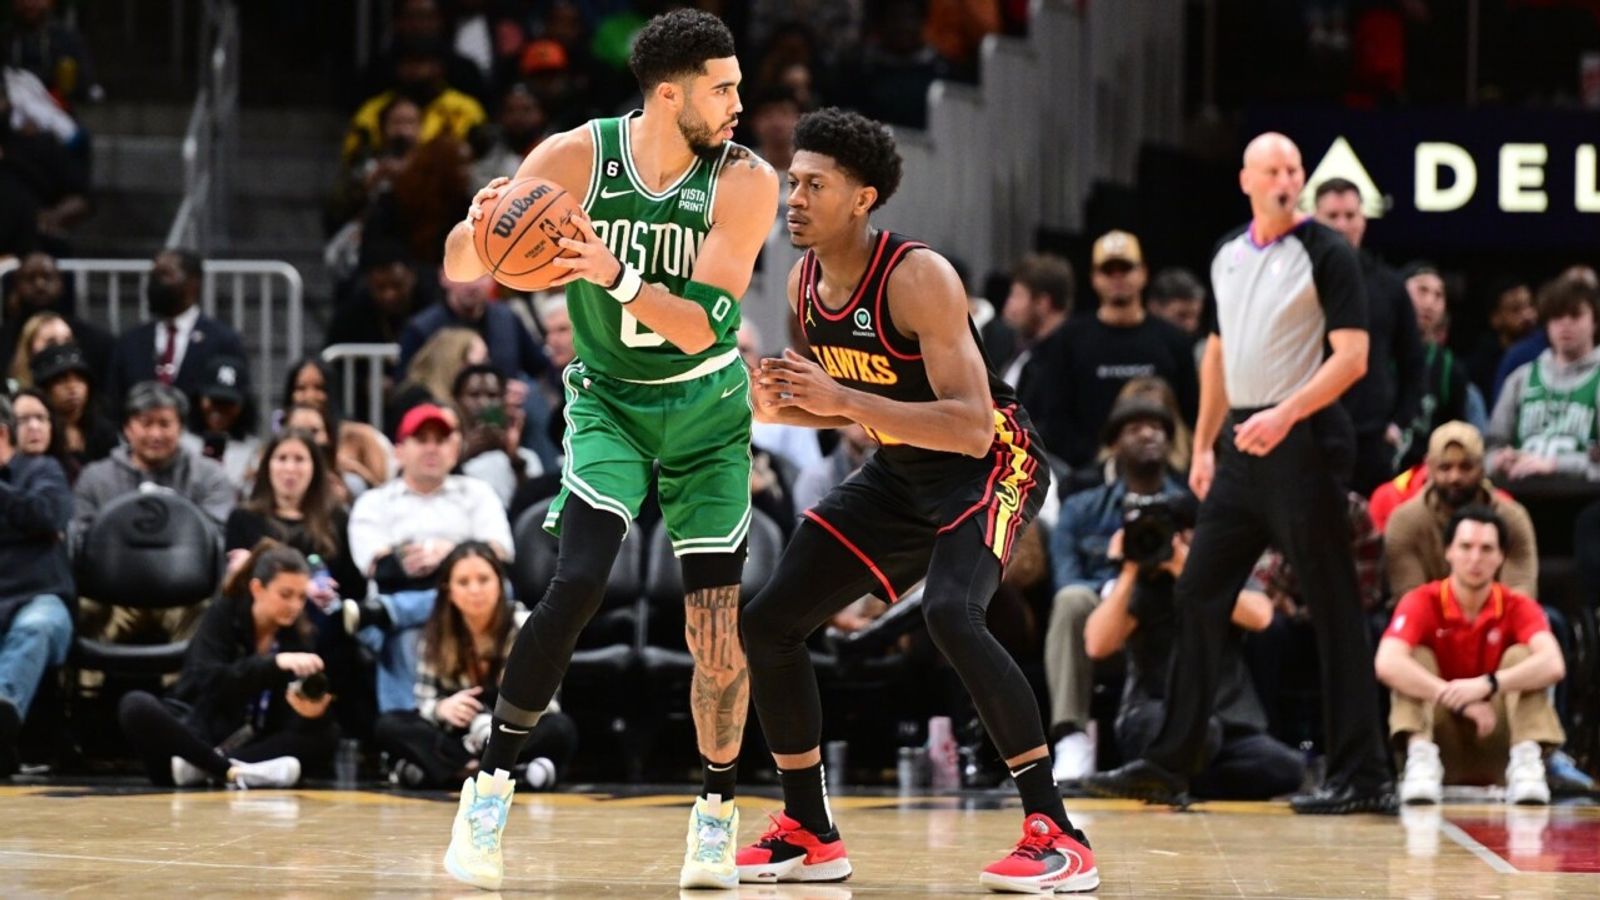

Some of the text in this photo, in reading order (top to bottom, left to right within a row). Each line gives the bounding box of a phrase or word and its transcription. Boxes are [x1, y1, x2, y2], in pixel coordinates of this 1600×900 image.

[606, 160, 619, 177] 6
[681, 187, 706, 205] VISTA
[492, 184, 554, 238] Wilson
[678, 199, 704, 213] PRINT
